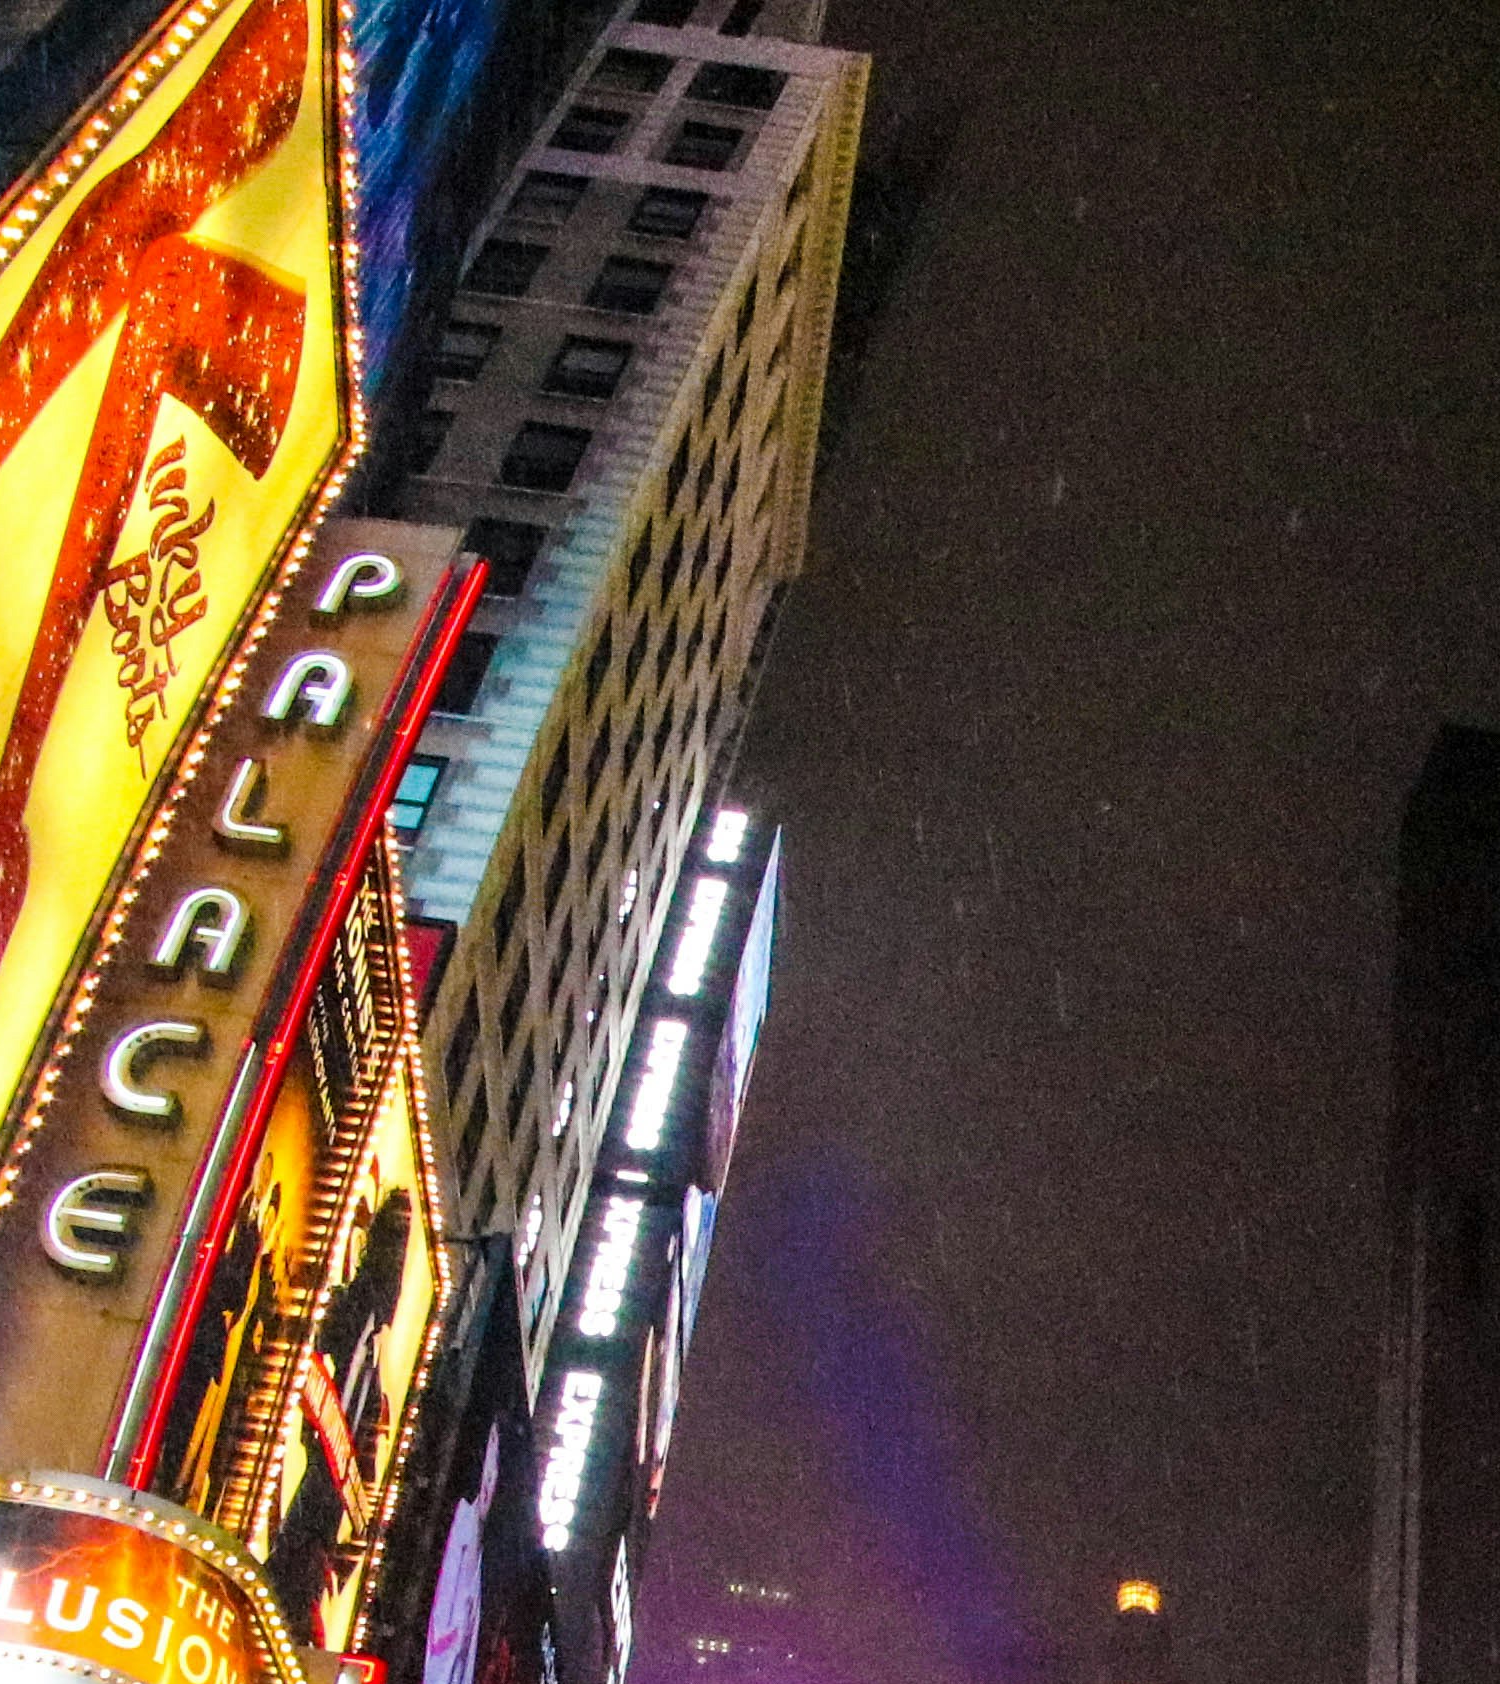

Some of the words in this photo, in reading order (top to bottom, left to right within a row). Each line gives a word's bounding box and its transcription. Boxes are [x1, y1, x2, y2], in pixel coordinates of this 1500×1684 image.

[104, 550, 169, 781] Boots
[45, 552, 401, 1272] PALACE
[175, 1577, 236, 1641] THE
